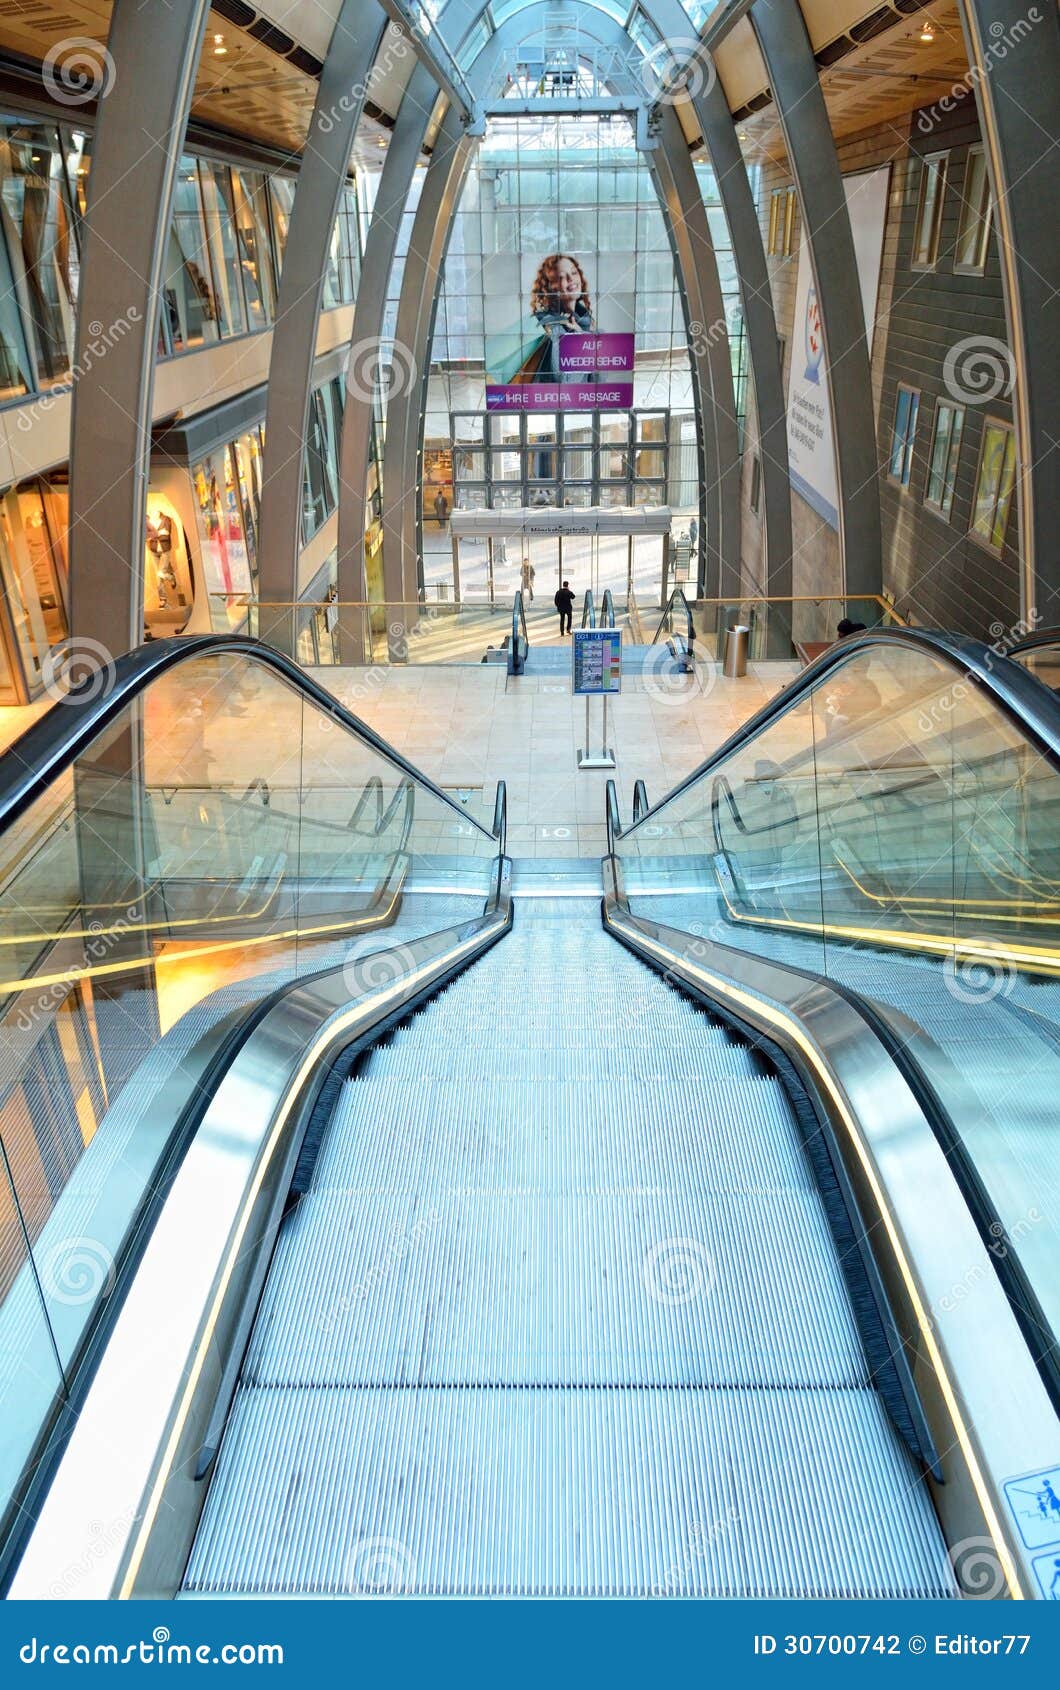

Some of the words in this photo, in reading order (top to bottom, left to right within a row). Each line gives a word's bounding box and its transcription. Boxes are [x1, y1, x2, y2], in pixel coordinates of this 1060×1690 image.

[582, 340, 603, 351] AUF
[534, 392, 572, 403] EUROPA
[578, 391, 621, 402] PASSAGE
